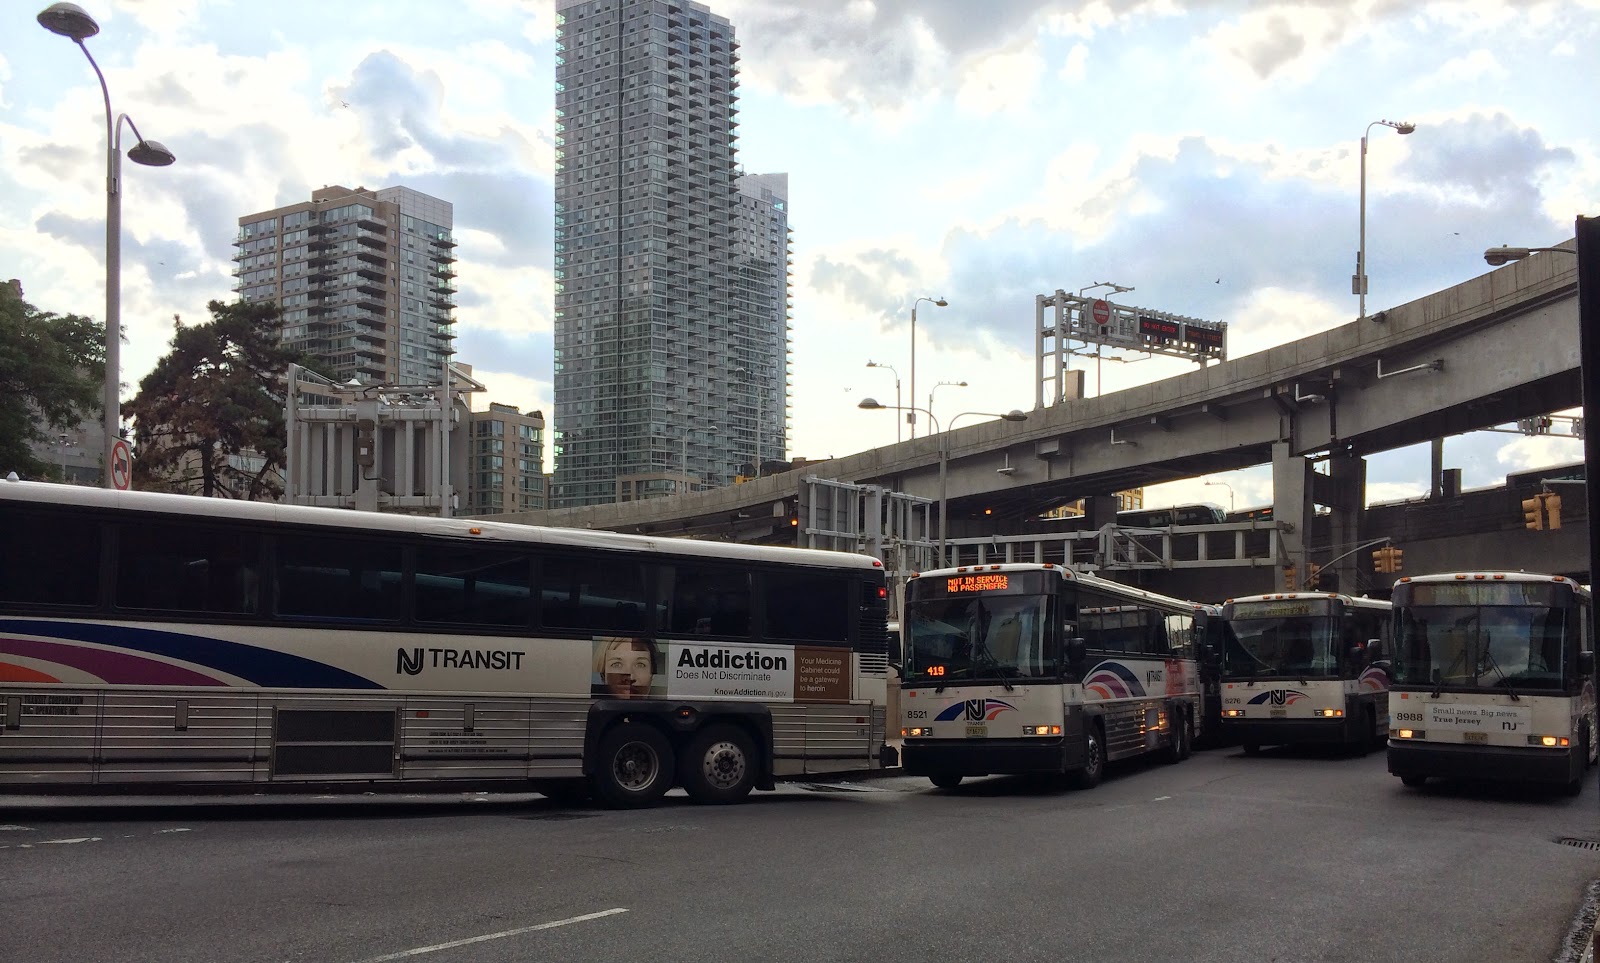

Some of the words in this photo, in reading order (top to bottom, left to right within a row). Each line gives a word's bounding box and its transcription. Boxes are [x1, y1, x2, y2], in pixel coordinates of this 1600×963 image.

[948, 577, 963, 585] NOT
[965, 576, 975, 585] IN
[976, 575, 1008, 584] SERVICE
[960, 582, 1008, 591] PASSENGERS
[396, 648, 425, 676] NJ
[428, 648, 526, 670] TRANSIT
[677, 648, 787, 671] Addiction
[800, 657, 815, 665] Your
[816, 657, 842, 666] Medicine
[800, 666, 823, 674] Cabinet
[927, 665, 945, 676] 419
[676, 670, 699, 680] Does
[701, 670, 718, 680] Not
[719, 671, 771, 682] Discriminate
[814, 676, 839, 685] gateway
[1270, 689, 1286, 705] NJ
[907, 710, 928, 719] 8521
[965, 699, 986, 721] NJ
[1432, 707, 1455, 715] Small
[1480, 709, 1494, 718] Big
[1396, 712, 1423, 722] 8988
[1455, 716, 1482, 725] Jersey
